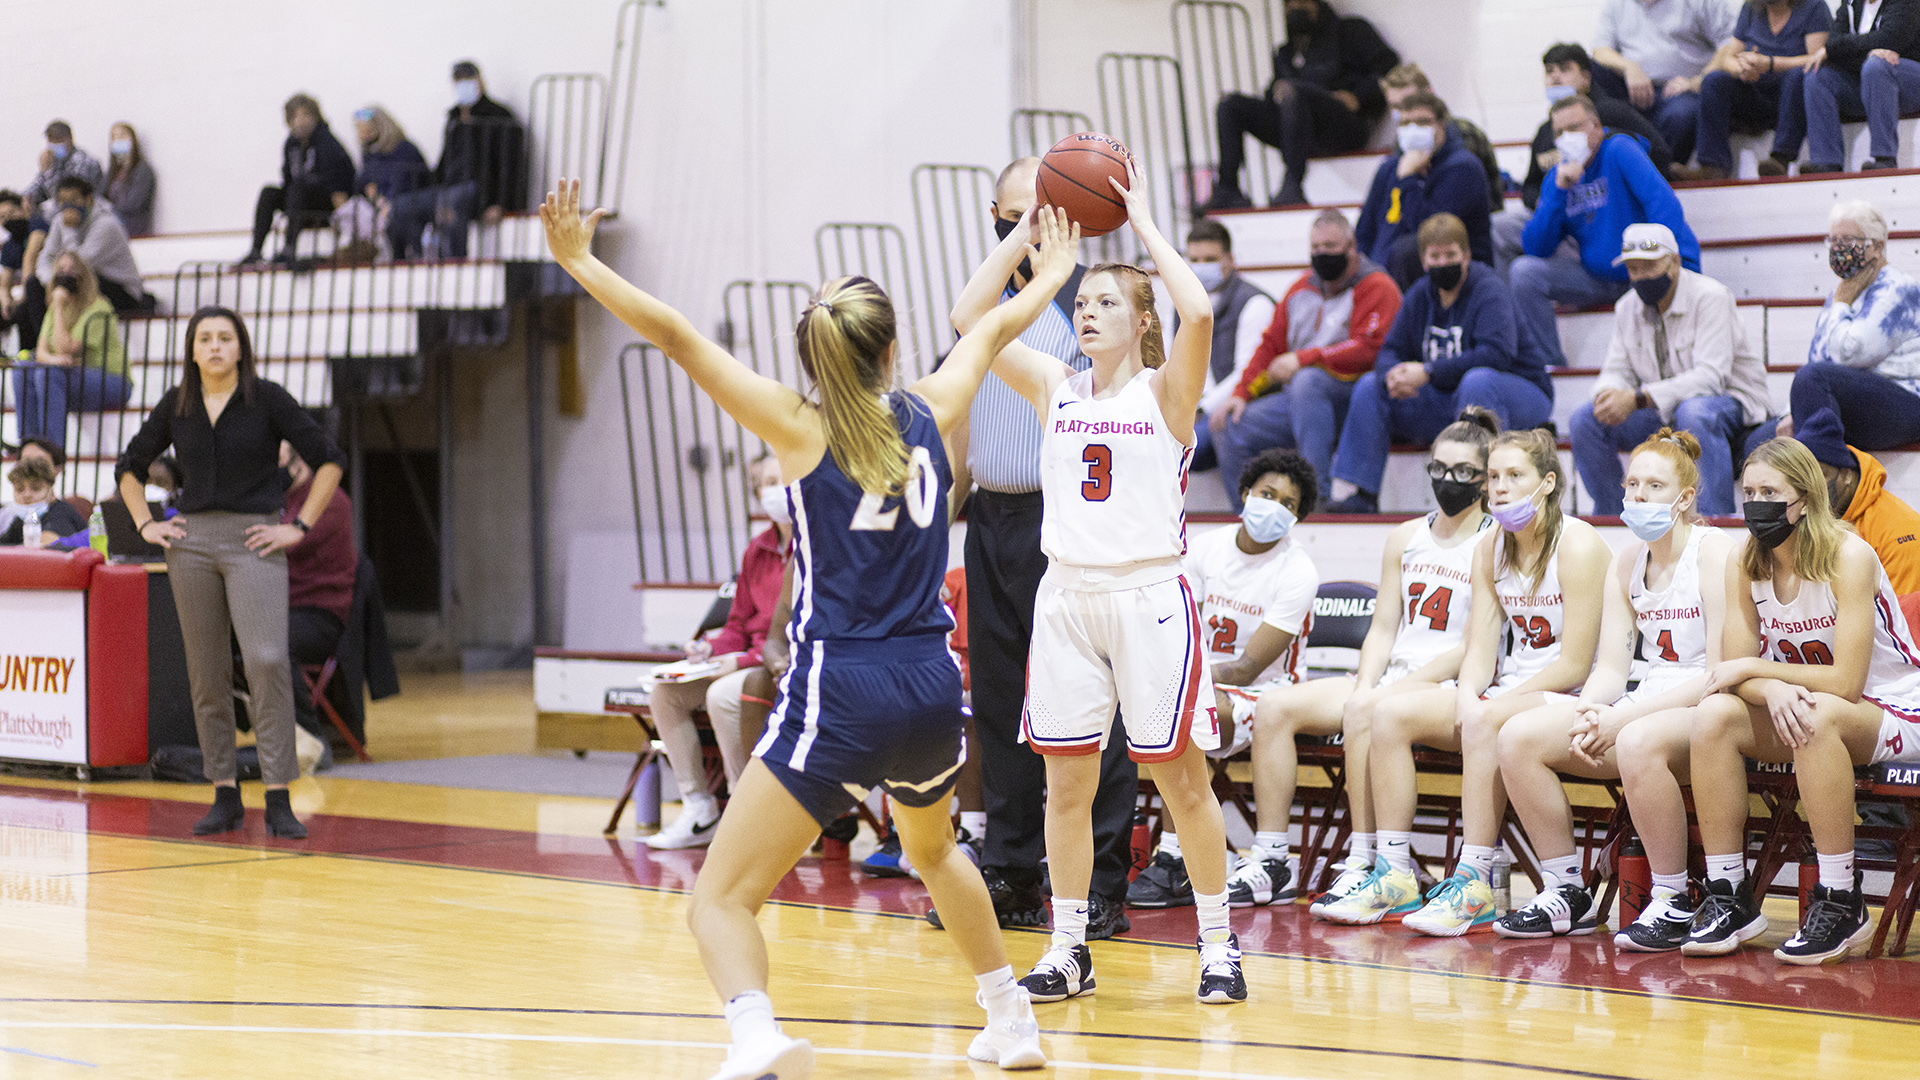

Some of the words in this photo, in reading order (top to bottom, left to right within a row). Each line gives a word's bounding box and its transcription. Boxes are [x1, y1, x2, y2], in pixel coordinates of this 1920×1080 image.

[1055, 419, 1154, 435] PLATTSBURGH
[1081, 443, 1112, 502] 3
[1313, 597, 1376, 617] RDINALS
